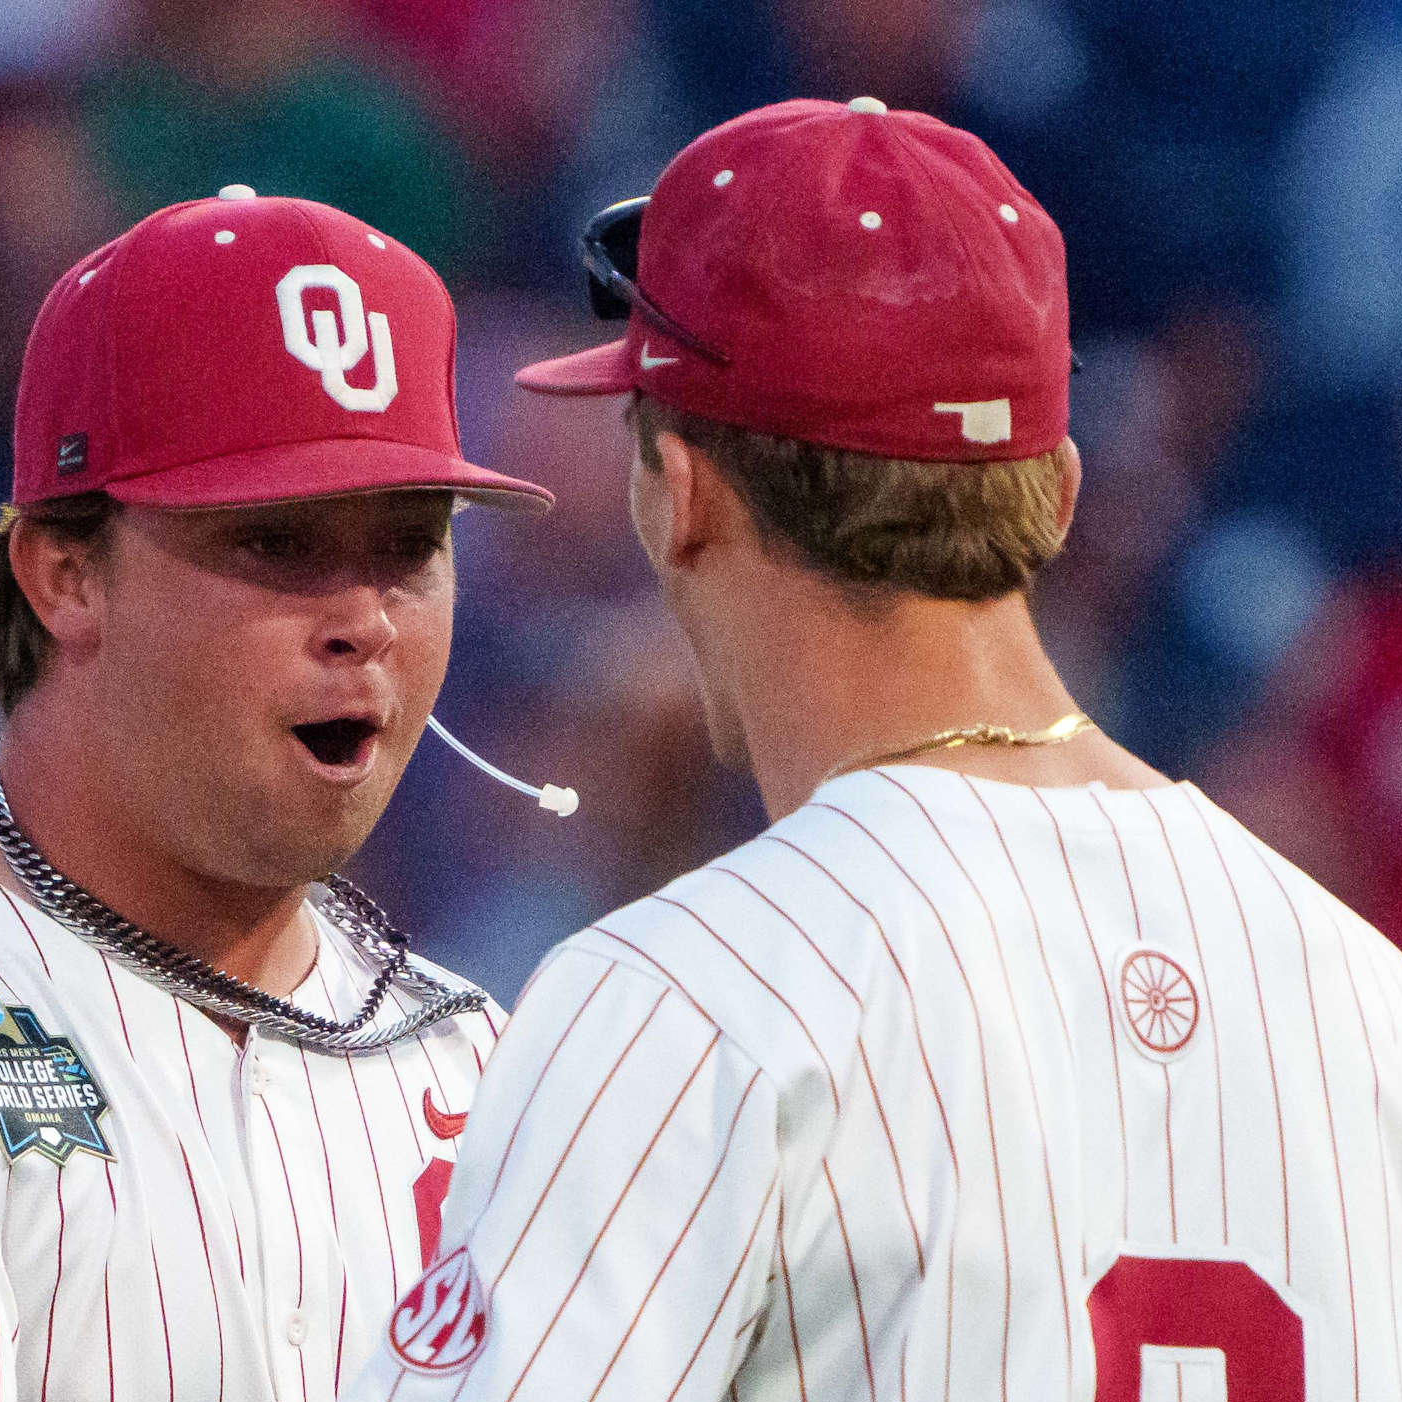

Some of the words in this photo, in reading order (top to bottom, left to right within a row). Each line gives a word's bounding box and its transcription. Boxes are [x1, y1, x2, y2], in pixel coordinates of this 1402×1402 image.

[275, 264, 398, 413] OU
[9, 1047, 41, 1057] MEN'S
[33, 1085, 99, 1109] SERIES
[24, 1112, 63, 1123] OMAHA
